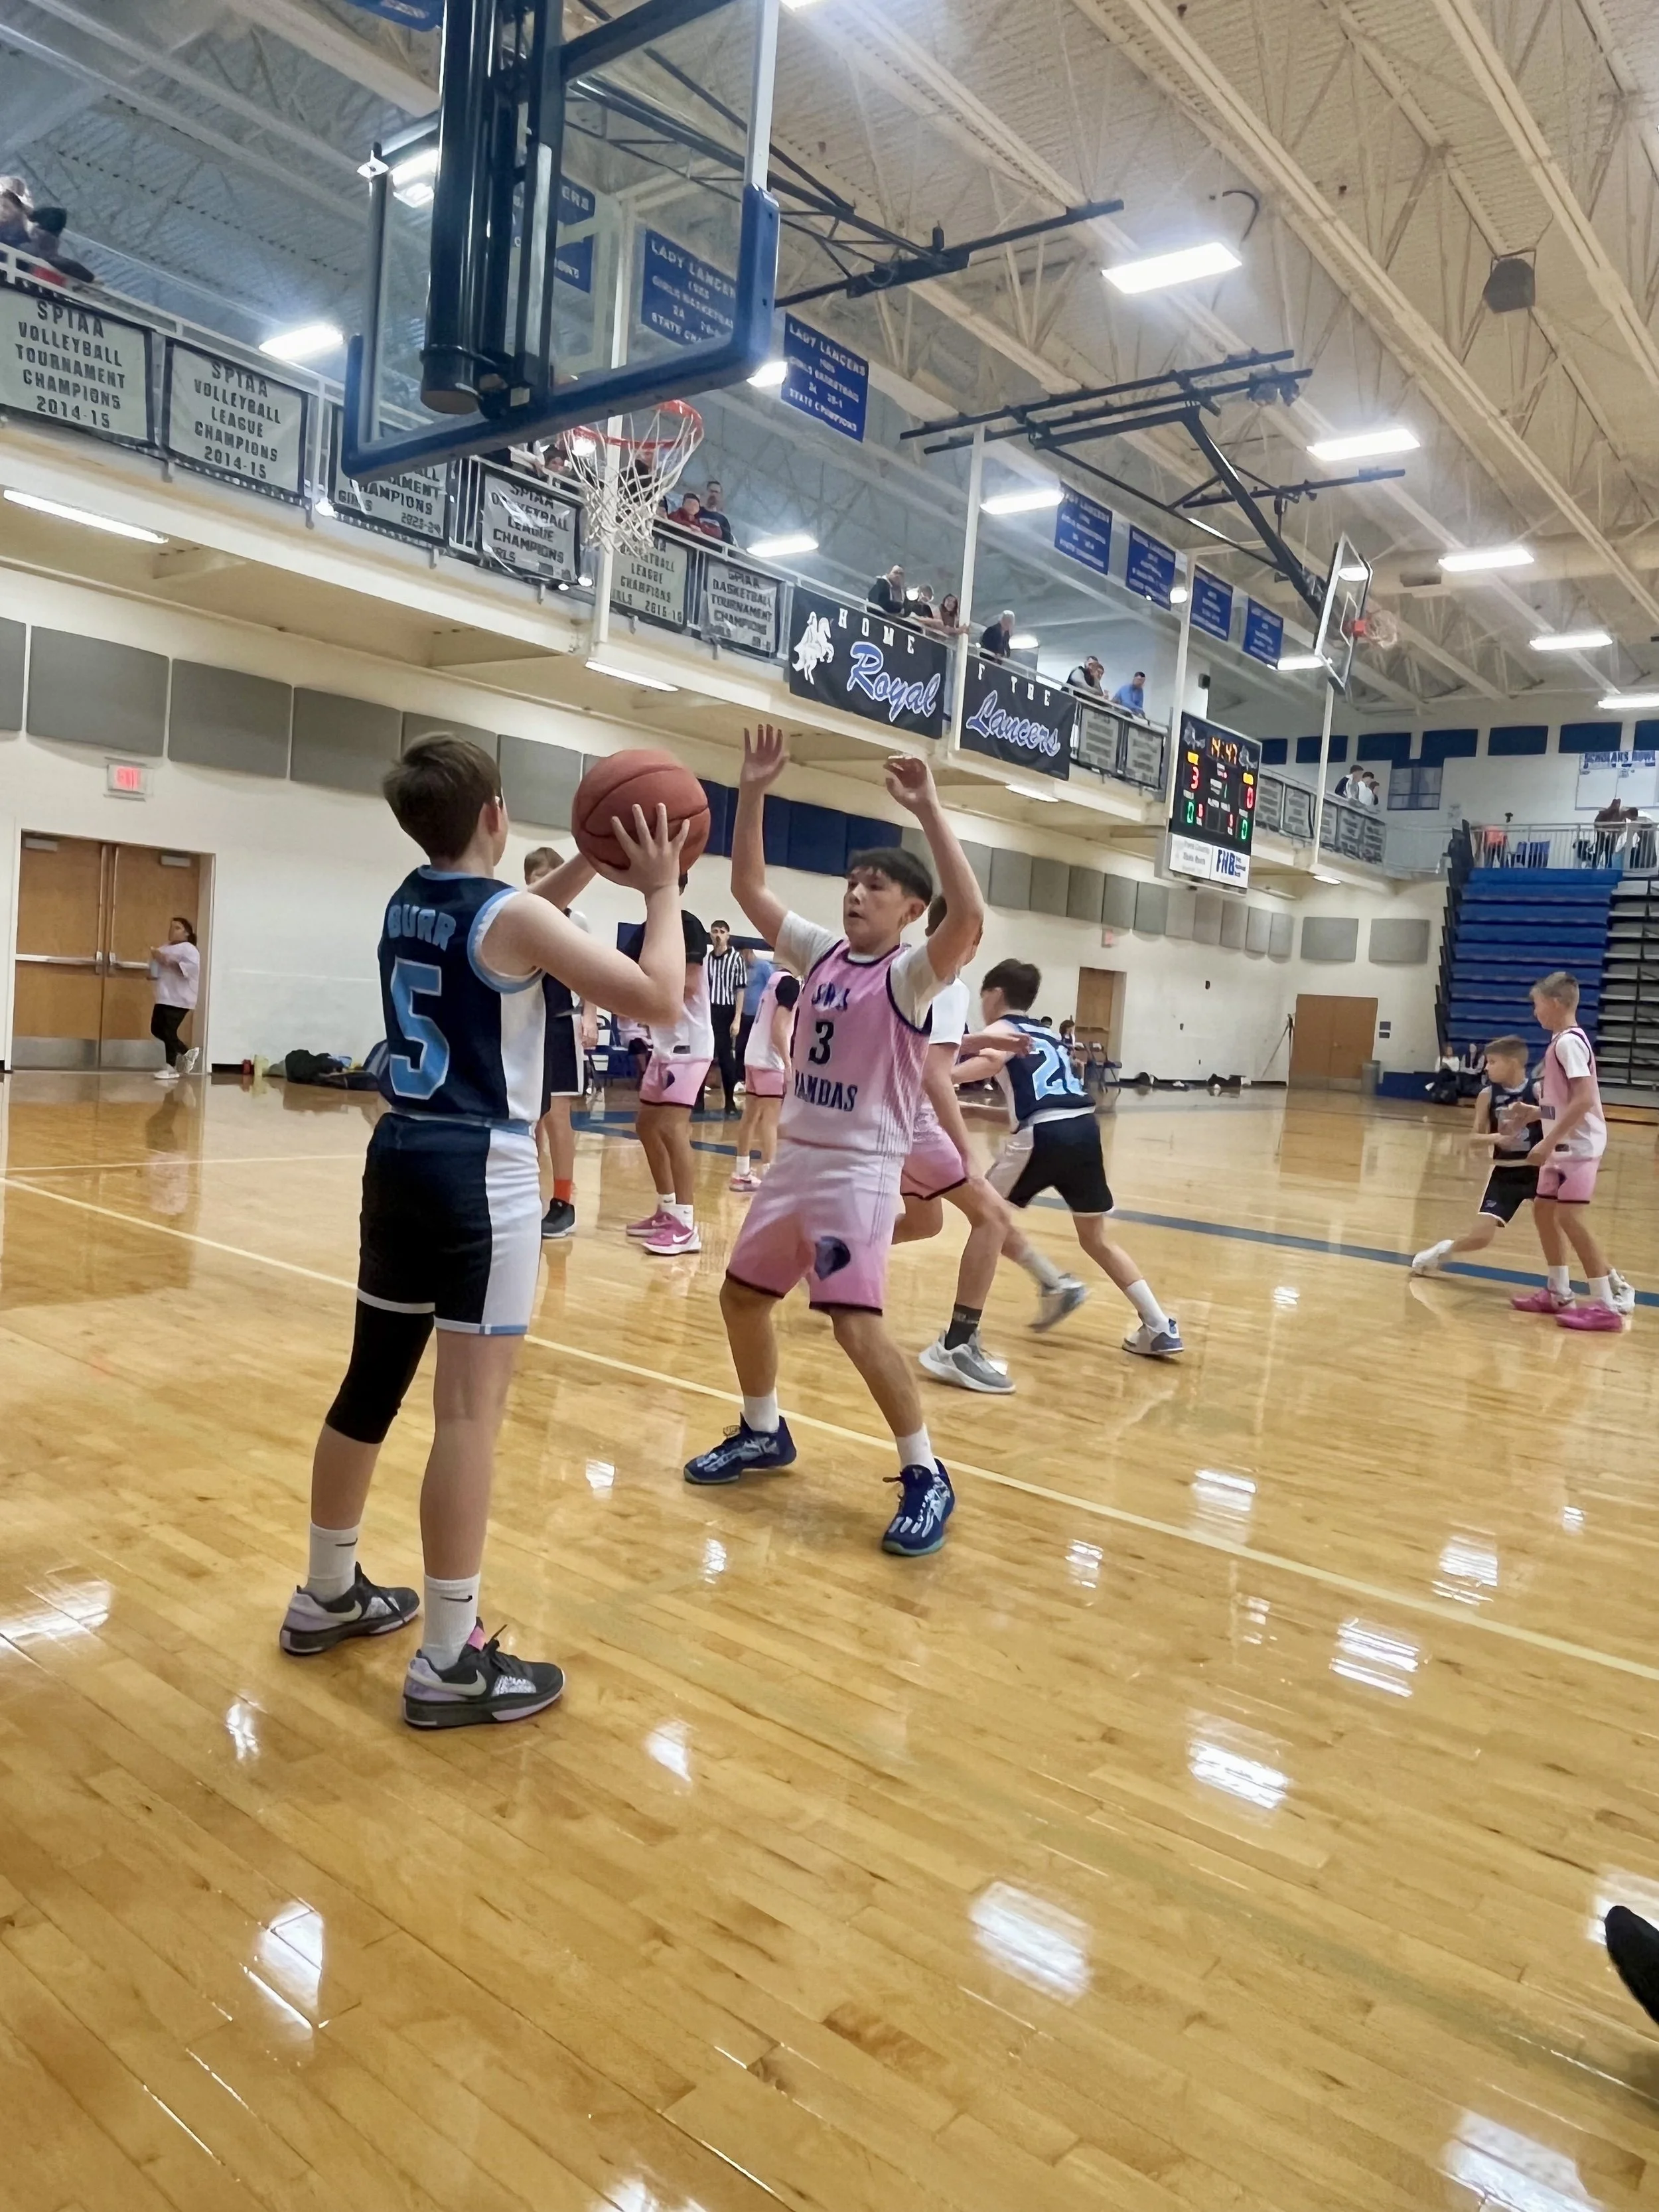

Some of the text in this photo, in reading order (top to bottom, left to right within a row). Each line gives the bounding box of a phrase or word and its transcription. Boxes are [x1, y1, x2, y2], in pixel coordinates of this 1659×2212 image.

[652, 239, 735, 299] LADY LANCER
[37, 300, 104, 338] SPIAA
[19, 321, 122, 367] VOLLEYBALL
[820, 340, 865, 377] LANCERS
[15, 343, 125, 389] TOURNAMENT
[211, 361, 268, 398] SPIAA
[23, 369, 121, 409] CHAMPIONS
[194, 379, 281, 424] VOLLEYBALL
[37, 396, 109, 429] 2014-15
[212, 406, 263, 437] LEAGUE
[194, 421, 277, 462] CHAMPIONS
[204, 446, 266, 479] 2014-15
[493, 528, 564, 564] CHAMPIONS
[837, 607, 915, 655] HOME
[1011, 675, 1051, 707] THE
[846, 640, 941, 723] Royal
[966, 689, 1060, 757] Lancers
[1190, 766, 1200, 790] 3
[389, 954, 450, 1100] 5
[808, 1021, 835, 1065] 3
